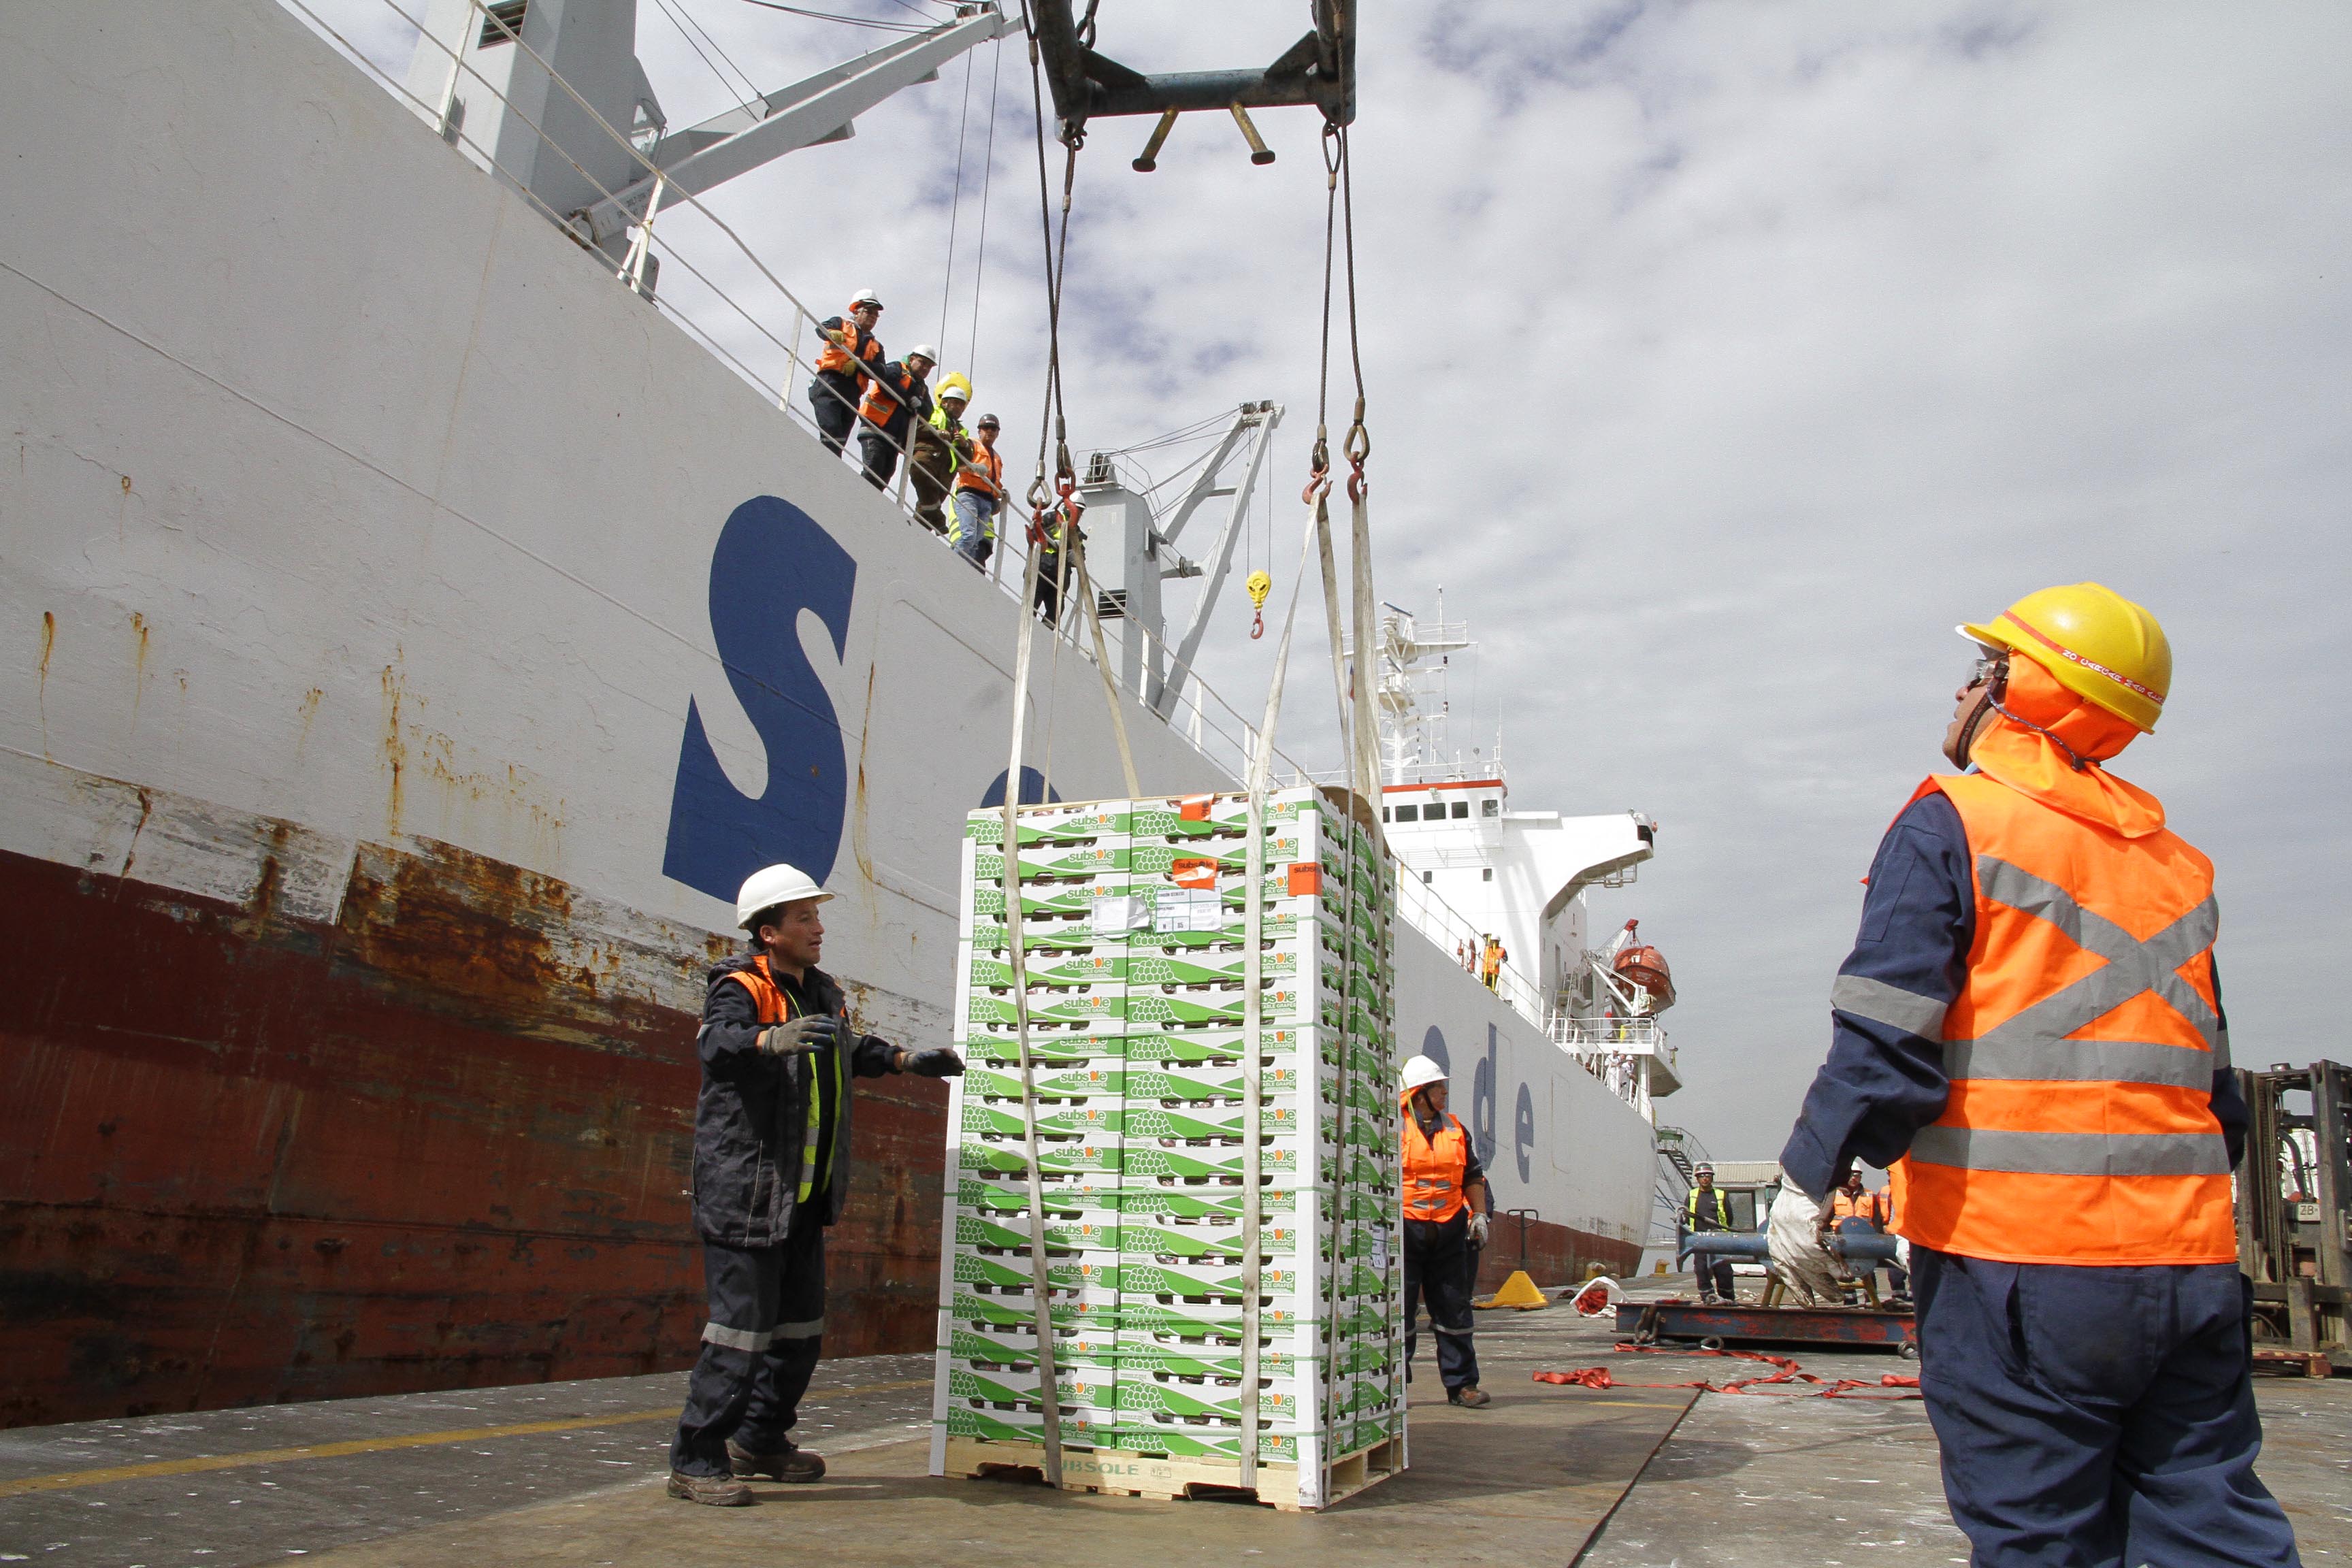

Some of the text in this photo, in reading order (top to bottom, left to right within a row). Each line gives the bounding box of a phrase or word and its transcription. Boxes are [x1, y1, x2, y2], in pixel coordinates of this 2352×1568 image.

[2062, 649, 2077, 661] NO
[2080, 658, 2123, 682] CARGAR
[2124, 679, 2145, 693] MAS
[1267, 802, 1296, 814] sole
[1071, 815, 1116, 828] subsole
[1266, 838, 1297, 851] sole
[1068, 849, 1115, 862] subsole
[1178, 861, 1213, 869] subsole
[1294, 865, 1319, 874] subs
[1066, 886, 1113, 898] subsole
[1262, 913, 1297, 925] bsole
[1066, 924, 1092, 934] subs
[1065, 958, 1113, 970] subsole
[1261, 953, 1296, 964] bsole
[1063, 996, 1111, 1009] subsole
[1261, 991, 1296, 1002] bsole
[1260, 1031, 1296, 1043] bsole
[1060, 1071, 1108, 1083] subsole
[1261, 1069, 1296, 1081] bsole
[1057, 1109, 1107, 1122] subsole
[1261, 1109, 1296, 1121] bsole
[1054, 1146, 1103, 1158] subsole
[1260, 1149, 1296, 1162] bsole
[1260, 1190, 1294, 1201] sole
[1052, 1224, 1102, 1236] subsole
[1260, 1228, 1294, 1241] sole
[1052, 1264, 1102, 1277] subsole
[1260, 1270, 1294, 1281] sole
[1261, 1310, 1294, 1322] sole
[1259, 1352, 1293, 1365] sole
[1056, 1381, 1096, 1396] ubsole
[1259, 1393, 1294, 1407] sole
[1258, 1435, 1294, 1450] sole
